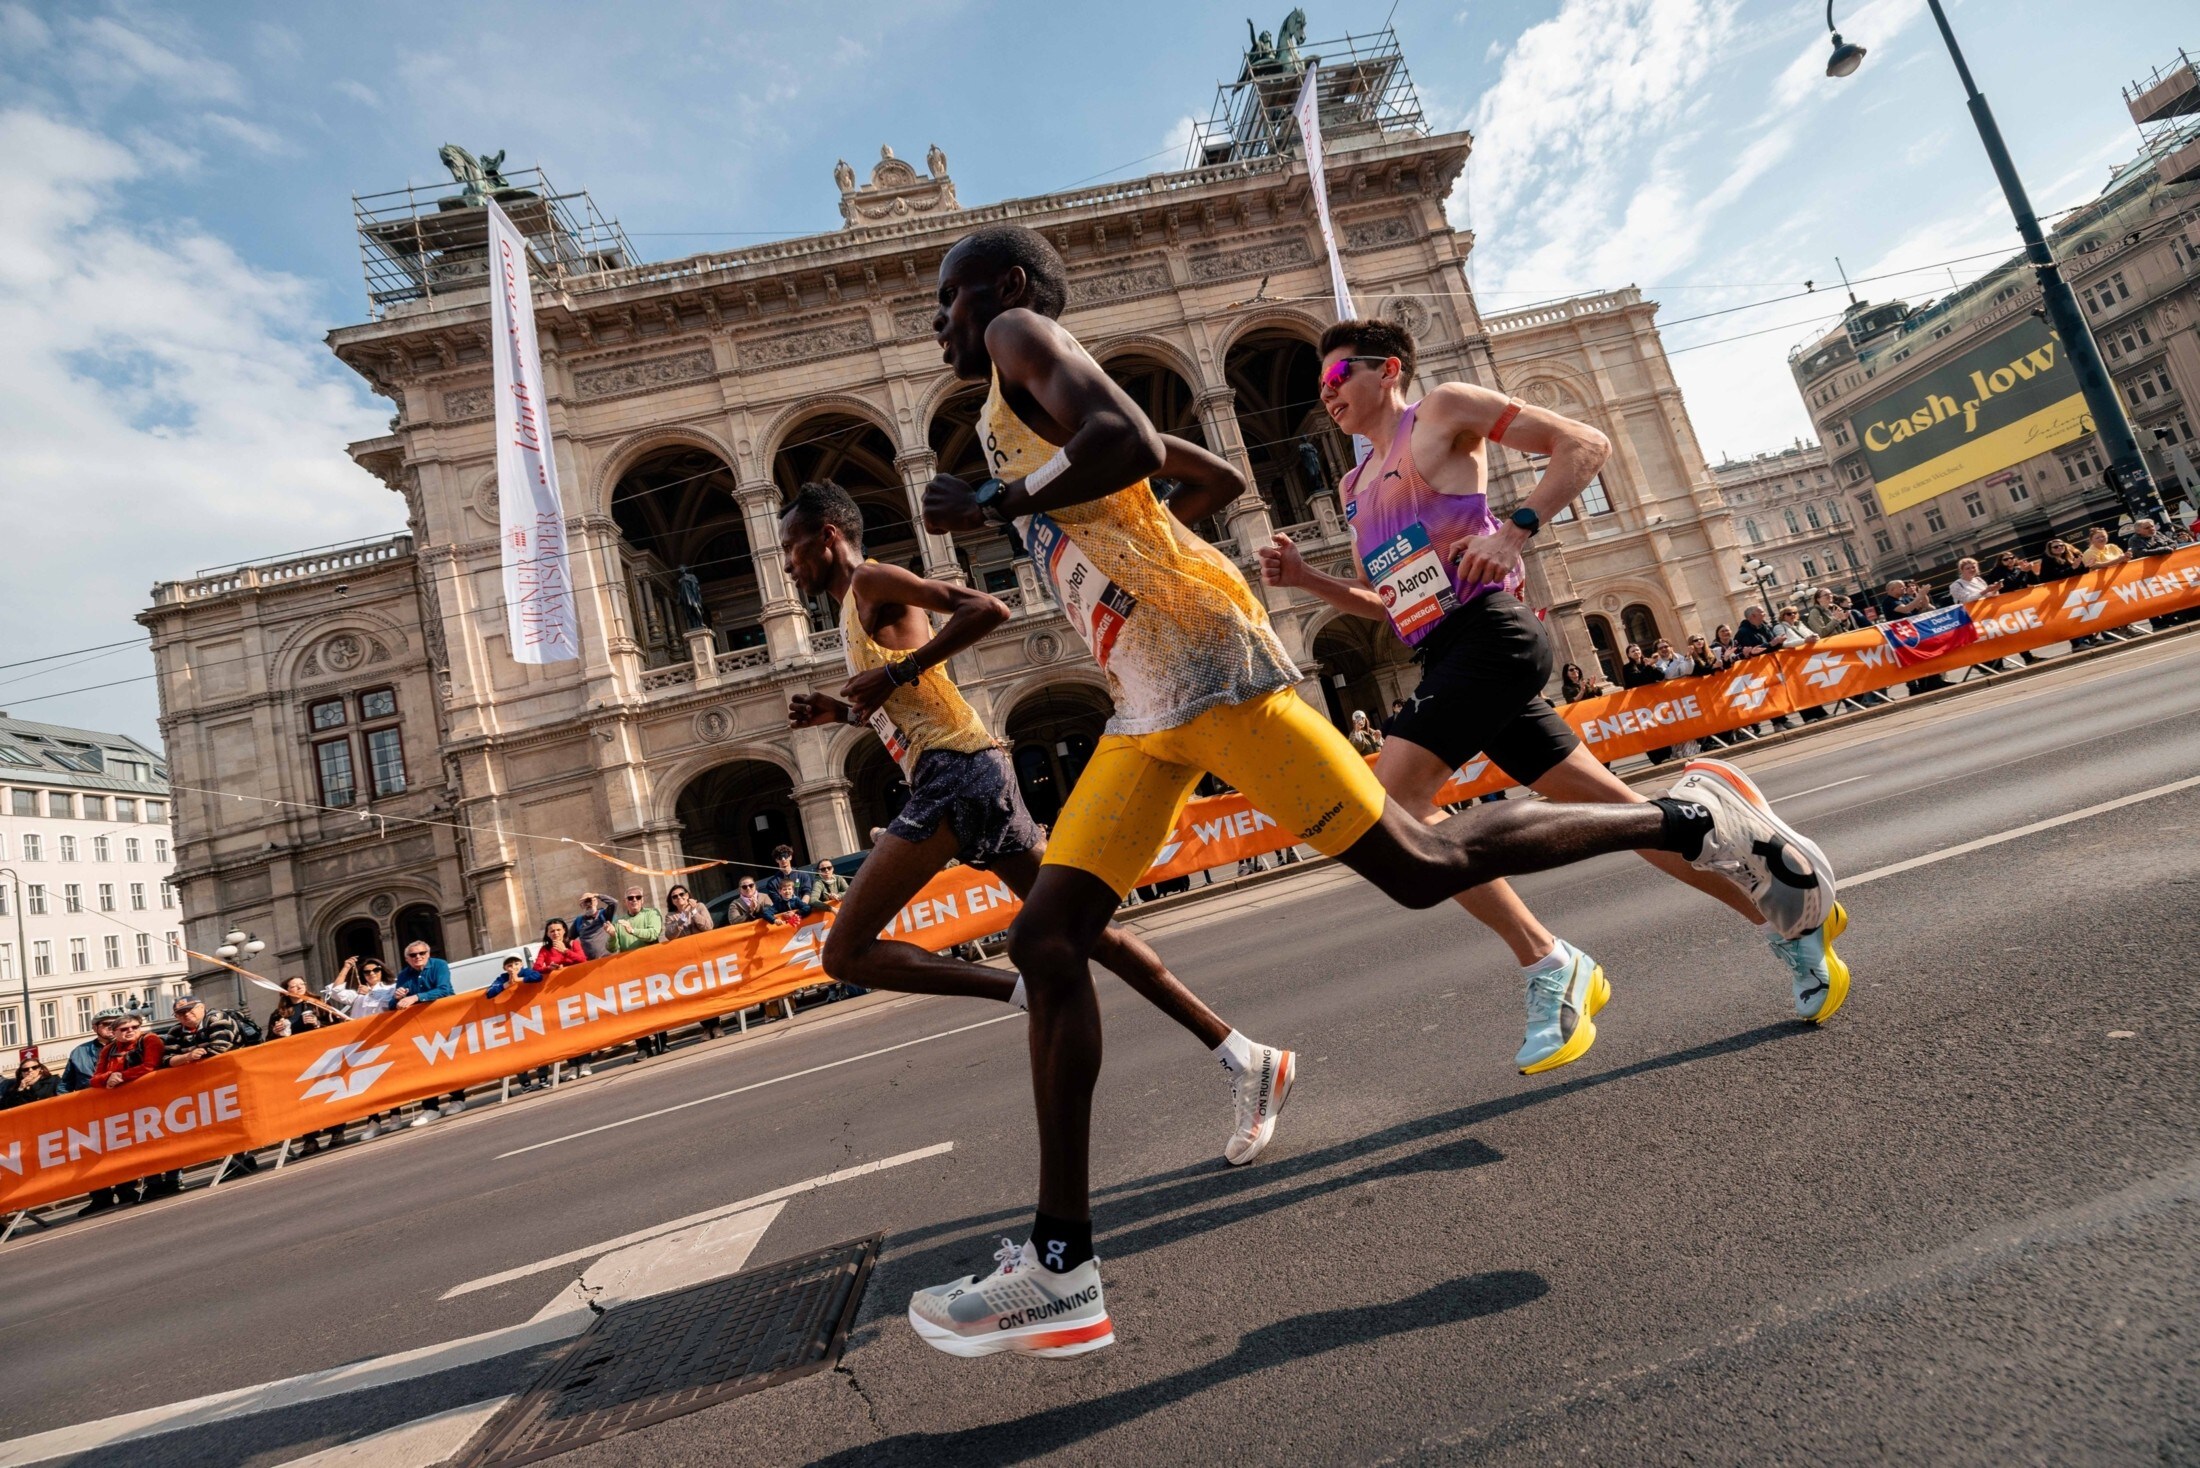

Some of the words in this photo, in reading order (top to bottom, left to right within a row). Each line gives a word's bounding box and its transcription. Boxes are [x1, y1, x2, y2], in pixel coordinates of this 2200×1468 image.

[1973, 304, 2013, 331] HOTEL
[536, 511, 566, 645] STAATSOPER
[1367, 545, 1399, 577] ERSTE
[1397, 565, 1439, 597] Aaron
[517, 558, 546, 647] WIENER
[2111, 571, 2183, 605] WIEN
[1411, 603, 1437, 621] ENERGIE
[1580, 694, 1703, 744] ENERGIE
[411, 1004, 546, 1067] WIEN
[557, 953, 743, 1029] ENERGIE
[1261, 1048, 1272, 1098] RUNNING
[37, 1083, 242, 1169] ENERGIE
[1258, 1099, 1268, 1117] ON
[998, 1314, 1025, 1331] ON
[1027, 1284, 1099, 1322] RUNNING
